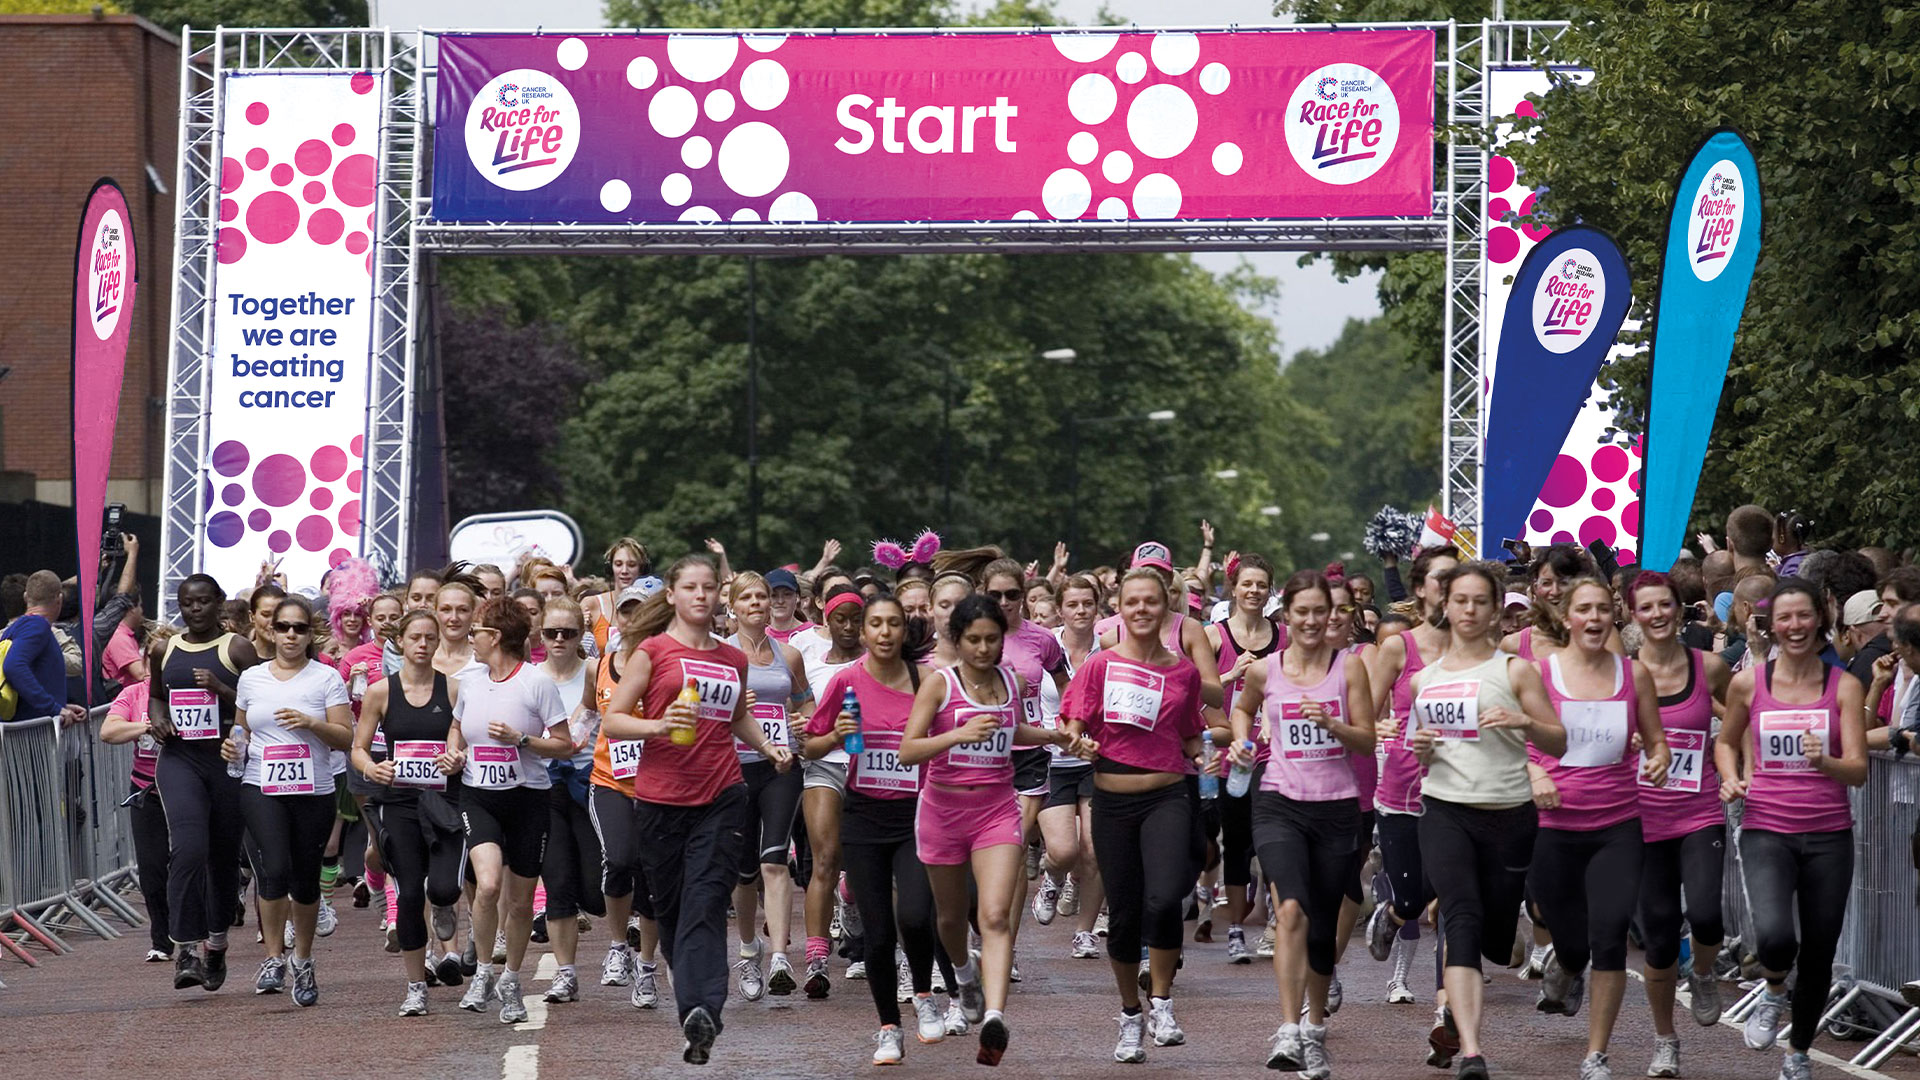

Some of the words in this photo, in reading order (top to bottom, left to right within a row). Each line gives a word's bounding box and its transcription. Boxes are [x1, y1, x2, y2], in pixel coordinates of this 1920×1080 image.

[480, 106, 531, 132] Race
[533, 105, 560, 124] for
[834, 93, 1018, 155] Start
[1300, 100, 1350, 125] Race
[1352, 98, 1379, 118] for
[492, 125, 563, 166] Life
[1312, 118, 1382, 160] Life
[1698, 194, 1722, 220] Race
[1722, 197, 1736, 216] for
[1696, 218, 1734, 254] Life
[94, 249, 111, 275] Race
[111, 249, 120, 268] for
[96, 270, 120, 312] Life
[1545, 275, 1578, 297] Race
[1577, 283, 1594, 299] for
[228, 292, 355, 320] Together
[1543, 298, 1592, 328] Life
[242, 329, 283, 346] we
[290, 329, 337, 346] are
[231, 353, 344, 382] beating
[239, 391, 335, 408] cancer
[695, 680, 732, 705] 140
[176, 708, 212, 726] 3374
[1424, 702, 1465, 724] 1884
[1290, 724, 1336, 746] 8914
[268, 762, 307, 782] 7231
[398, 761, 439, 778] 15362
[480, 765, 516, 784] 7094
